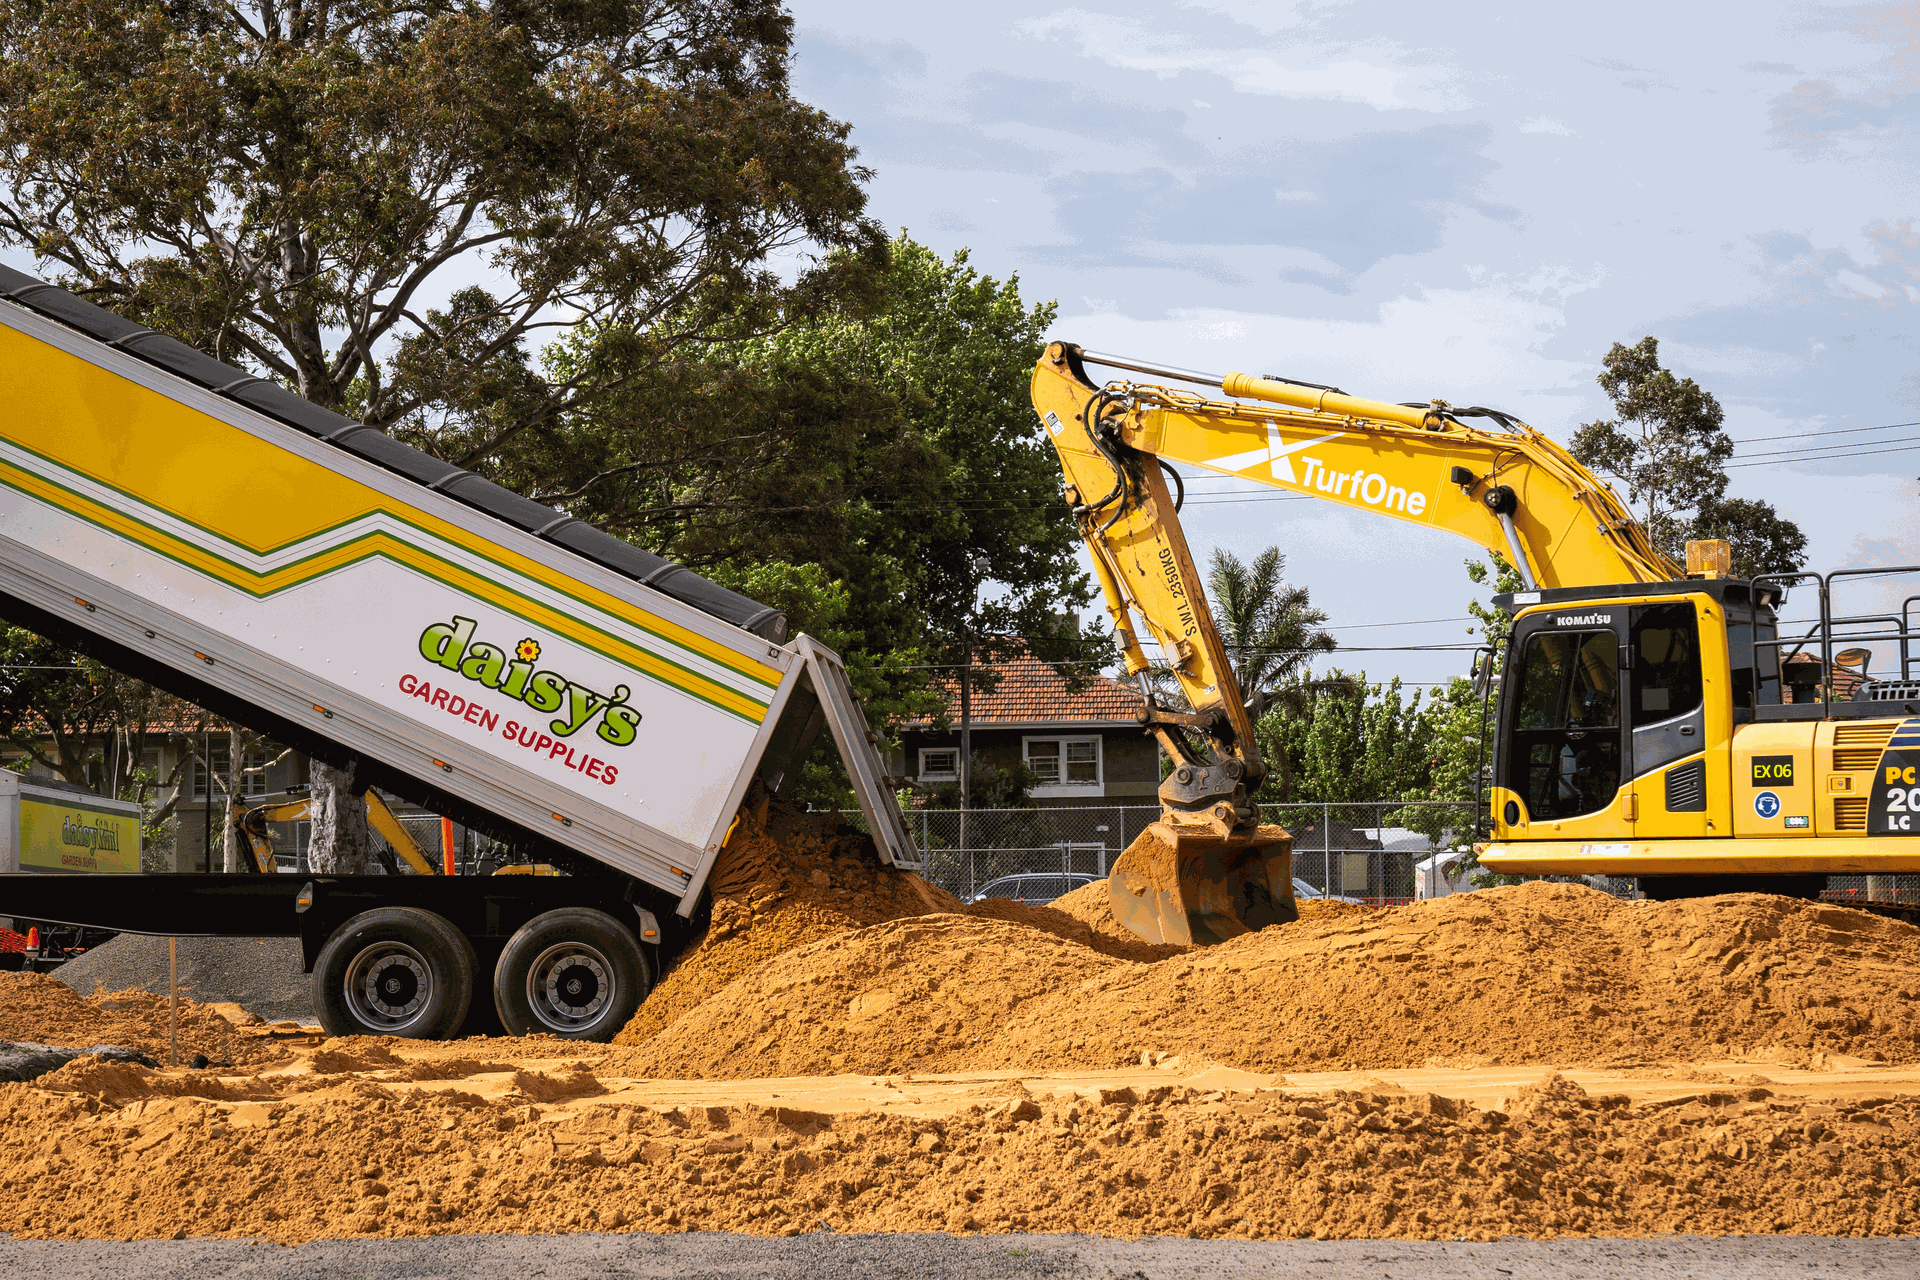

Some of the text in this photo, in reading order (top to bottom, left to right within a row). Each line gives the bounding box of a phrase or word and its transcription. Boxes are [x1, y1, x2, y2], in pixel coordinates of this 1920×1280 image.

[1301, 456, 1426, 515] TurfOne
[1557, 613, 1611, 626] KOMATSU
[418, 615, 642, 746] daisy's
[398, 674, 619, 785] GARDEN SUPPLIES
[1753, 764, 1792, 778] EX 06
[1885, 766, 1916, 785] PC
[1888, 815, 1911, 830] LC
